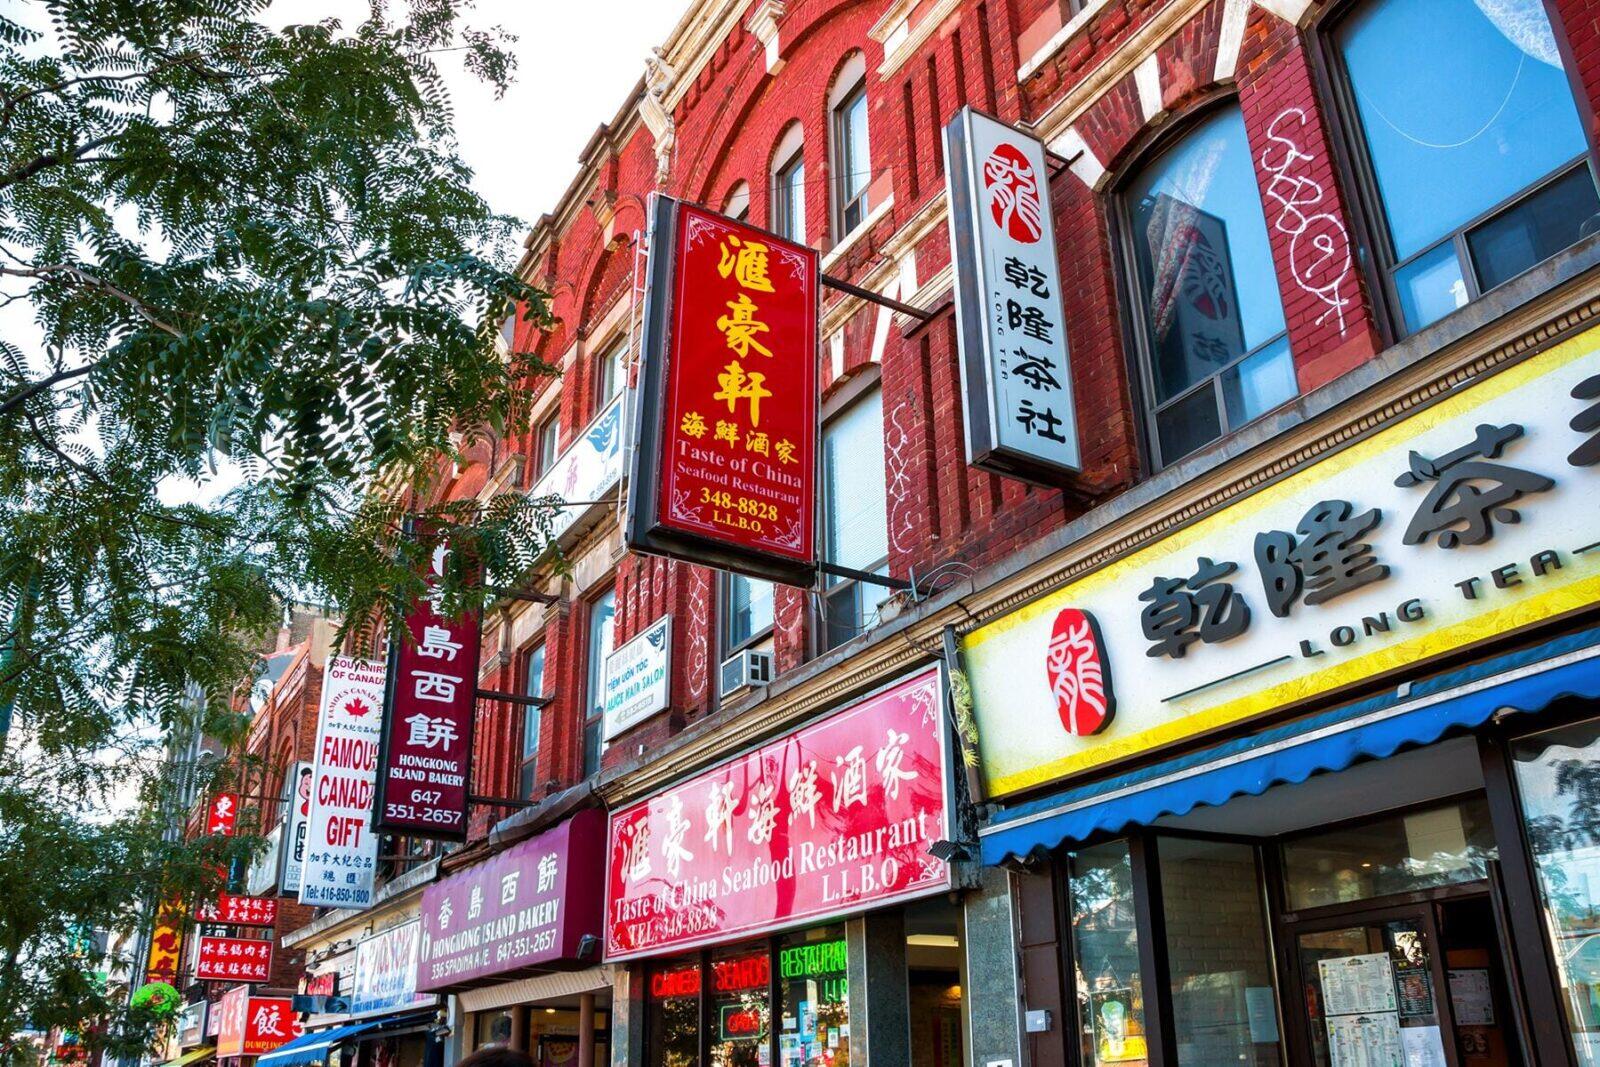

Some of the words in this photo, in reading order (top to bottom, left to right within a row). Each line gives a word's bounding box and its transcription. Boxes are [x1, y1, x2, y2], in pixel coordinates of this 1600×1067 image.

[994, 291, 1005, 336] LONG
[999, 348, 1009, 380] TEA
[1005, 256, 1066, 444] 乾隆茶社
[681, 411, 799, 464] 海鮮酒家
[677, 439, 725, 466] Taste
[730, 458, 748, 473] of
[752, 461, 801, 488] China
[677, 461, 728, 485] Seafood
[732, 477, 800, 505] Restaurant
[700, 487, 778, 521] 348-8828
[713, 510, 764, 534] L.L.B.O.
[1299, 598, 1425, 658] LONG
[1454, 550, 1562, 600] TEA
[332, 670, 345, 679] OF
[404, 584, 463, 751] 島西餅
[607, 691, 625, 713] ALICE
[625, 682, 641, 703] HAIR
[641, 666, 665, 689] SALON
[389, 767, 426, 782] ISLAND
[428, 772, 465, 787] BAKERY
[399, 754, 458, 772] HONGKONG
[386, 803, 462, 825] 351-2657
[411, 789, 441, 805] 647
[326, 815, 363, 848] GIFT
[615, 897, 650, 922] Taste
[654, 887, 668, 913] of
[671, 876, 717, 909] China
[722, 847, 793, 896] Seafood
[799, 807, 927, 875] Restaurant
[306, 885, 319, 899] Tel:
[321, 887, 370, 903] 416-850-1800
[438, 852, 558, 930] 香島西餅
[432, 926, 481, 960] HONGKONG
[482, 914, 516, 943] ISLAND
[518, 898, 559, 932] BAKERY
[661, 904, 718, 940] 348-8828
[497, 929, 557, 962] 647-351-2657
